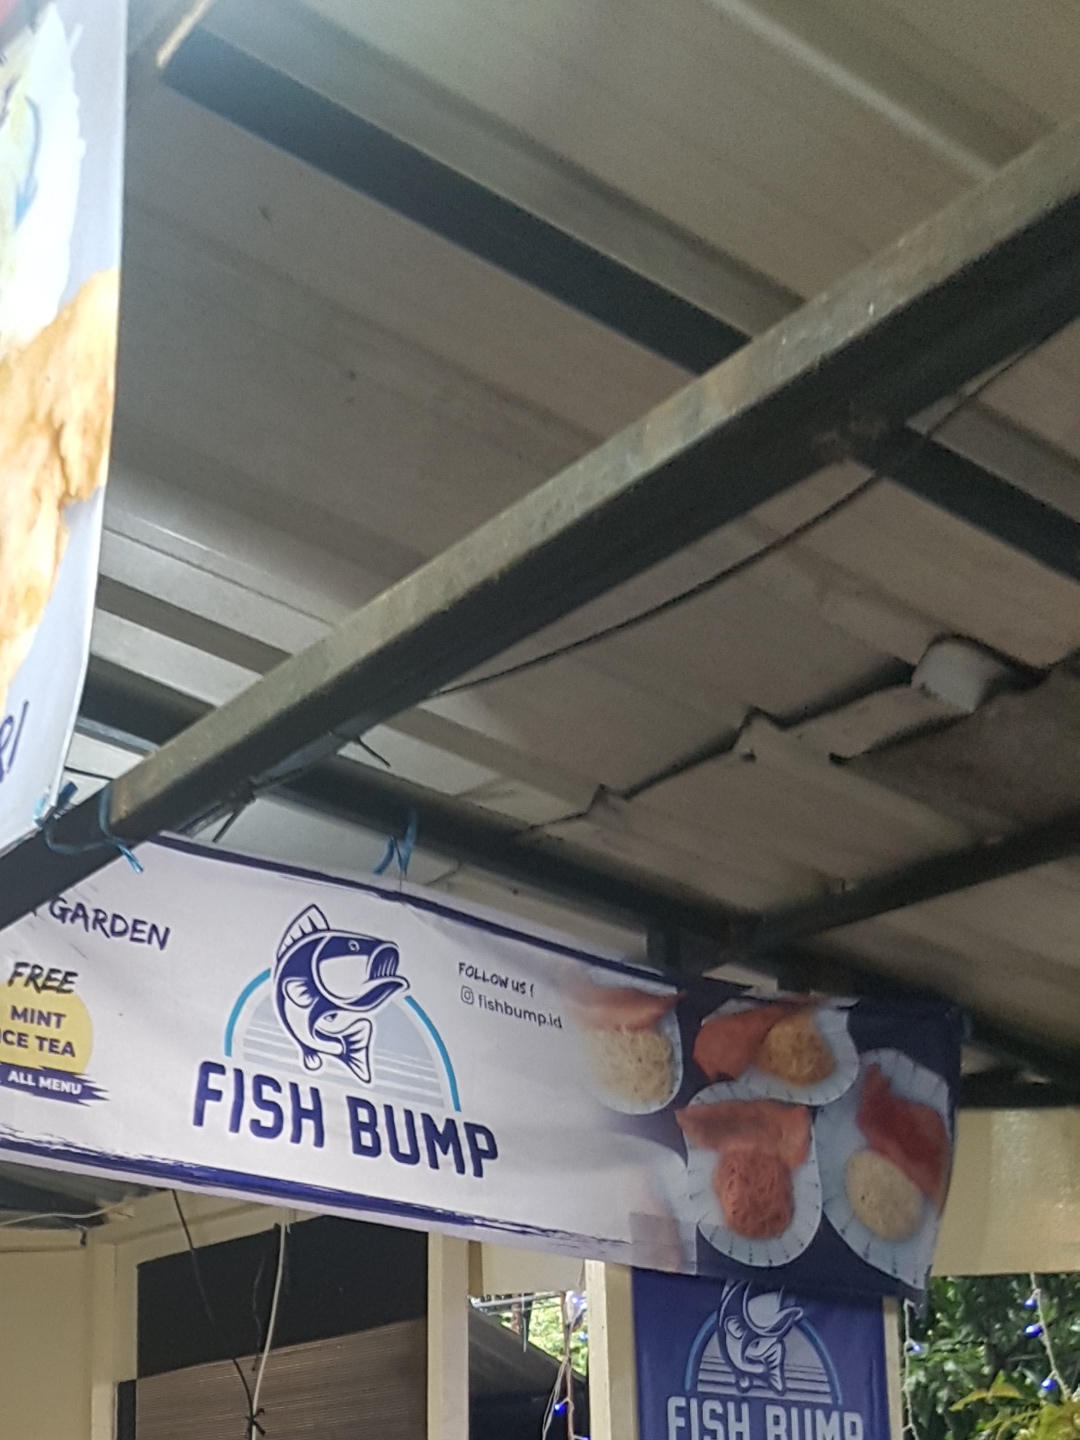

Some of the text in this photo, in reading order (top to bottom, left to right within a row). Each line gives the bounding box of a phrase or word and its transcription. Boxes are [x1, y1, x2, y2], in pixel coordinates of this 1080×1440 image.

[49, 896, 171, 951] GARDEN
[7, 961, 79, 994] FREE
[458, 962, 510, 989] FOLLOW
[10, 1005, 67, 1029] MINT
[478, 993, 563, 1029] fishbump.id
[35, 1035, 76, 1058] TEA
[7, 1071, 83, 1095] ALL MENU
[192, 1060, 499, 1178] FISH BUMP
